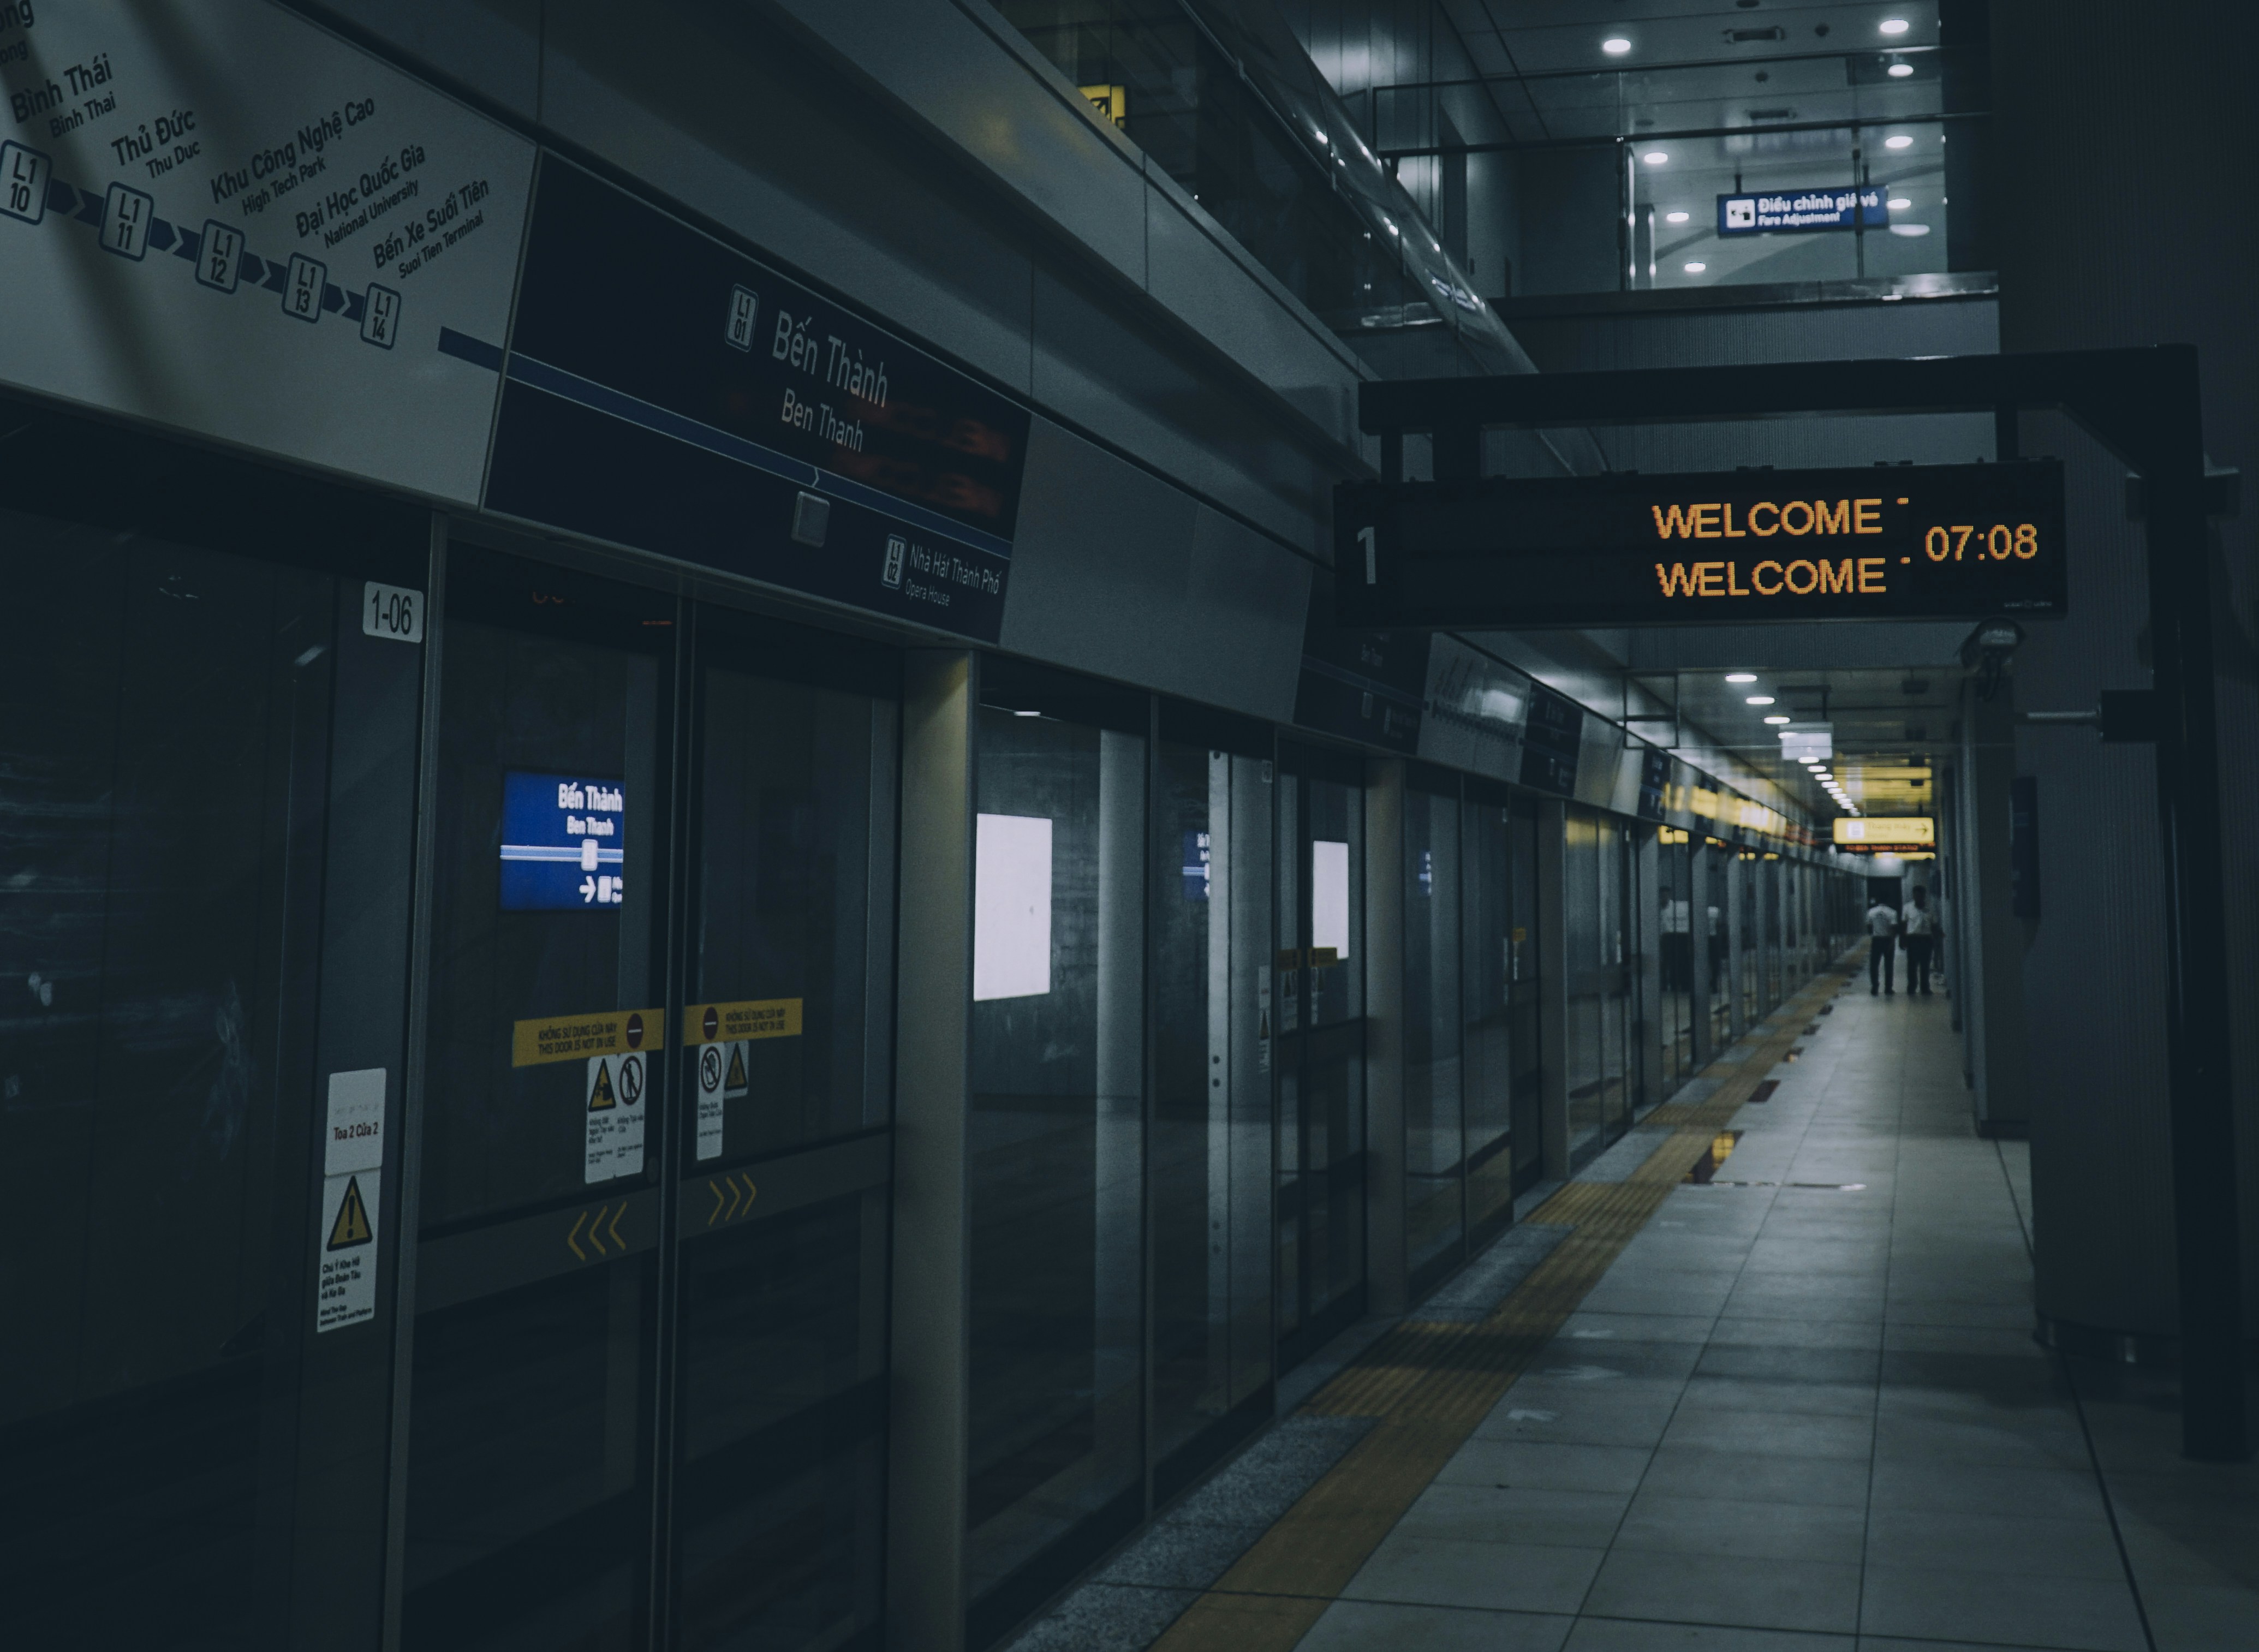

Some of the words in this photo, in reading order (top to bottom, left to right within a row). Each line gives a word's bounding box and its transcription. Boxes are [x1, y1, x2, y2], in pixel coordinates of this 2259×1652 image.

[10, 79, 63, 123] Bình
[64, 52, 112, 96] Thái
[49, 109, 84, 138] Binh
[84, 91, 116, 120] Thai
[111, 124, 152, 166] Thủ
[155, 110, 195, 145] Đức
[211, 170, 249, 204] Khu
[252, 142, 296, 180] Công
[297, 111, 343, 153] Nghệ
[345, 98, 374, 126] Cao
[13, 152, 37, 183] L1
[146, 155, 172, 178] Thu
[174, 141, 200, 164] Duc
[10, 183, 29, 212] 10
[242, 188, 270, 216] High
[271, 171, 298, 198] Tech
[299, 156, 327, 182] Park
[295, 202, 325, 237] Đại
[326, 187, 359, 219] Học
[360, 156, 399, 198] Quốc
[401, 144, 426, 172] Gia
[118, 193, 140, 223] L1
[324, 210, 368, 248] National
[369, 180, 419, 220] University
[1757, 215, 1781, 227] Fare
[1782, 212, 1840, 227] Adjustment
[118, 222, 133, 249] 11
[374, 231, 404, 269] Bến
[405, 221, 425, 248] Xe
[427, 192, 458, 232] Suối
[459, 180, 489, 210] Tiên
[214, 230, 233, 258] L1
[399, 253, 421, 279] Suoi
[421, 242, 443, 262] Tien
[443, 210, 484, 248] Terminal
[211, 257, 227, 283] 12
[298, 263, 315, 289] L1
[296, 288, 310, 313] 13
[375, 291, 391, 317] L1
[737, 294, 750, 318] L1
[372, 316, 385, 341] 14
[734, 318, 746, 342] 01
[772, 309, 818, 375] Bến
[826, 335, 888, 408] Thành
[782, 387, 813, 431] Ben
[820, 402, 863, 452] Thanh
[1652, 499, 1882, 539] WELCOME
[891, 541, 901, 562] L1
[1357, 526, 1376, 584] 1
[1925, 523, 2037, 562] 07:08
[887, 562, 898, 582] 02
[909, 543, 930, 572] Nhà
[932, 551, 950, 579] Hát
[952, 557, 980, 588] Thành
[981, 568, 1002, 594] Phố
[1655, 557, 1886, 597] WELCOME
[905, 578, 927, 601] Opera
[928, 585, 950, 606] House
[372, 590, 412, 635] 1-06
[558, 782, 583, 809] Bến
[585, 785, 622, 812] Thành
[567, 815, 586, 834] Ben
[586, 816, 614, 836] Thanh
[538, 1042, 553, 1054] THIS
[555, 1040, 573, 1053] DOOR
[574, 1039, 581, 1051] IS
[582, 1037, 594, 1049] NOT
[597, 1037, 603, 1048] IN
[604, 1035, 616, 1047] USE
[334, 1126, 347, 1140] Toa
[349, 1125, 354, 1138] 2
[356, 1123, 371, 1137] Cửa
[373, 1122, 378, 1135] 2
